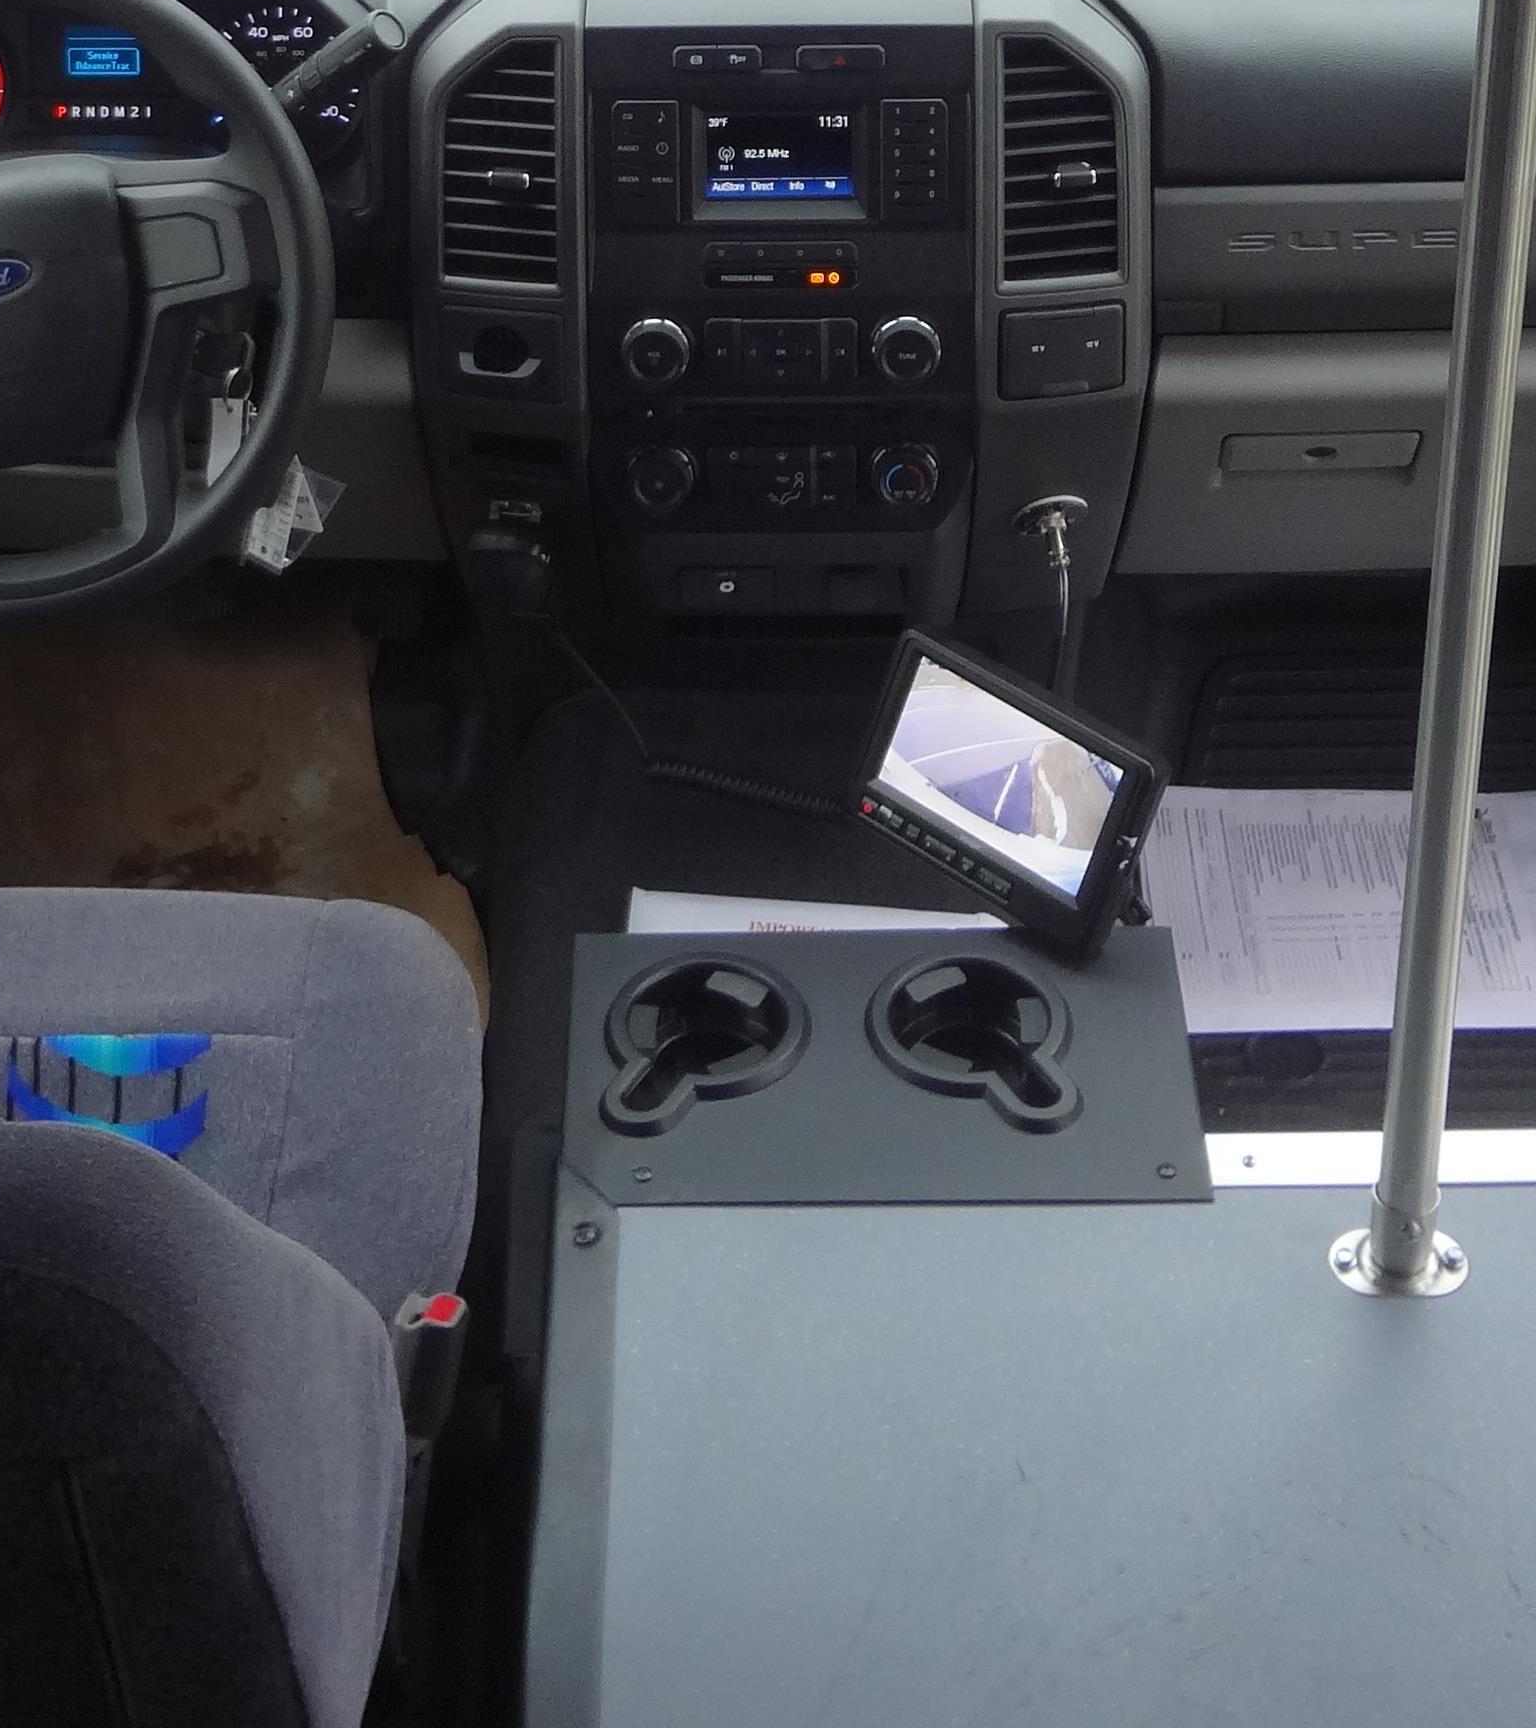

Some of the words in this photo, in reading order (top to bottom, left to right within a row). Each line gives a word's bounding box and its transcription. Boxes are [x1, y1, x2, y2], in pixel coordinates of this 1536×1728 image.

[248, 26, 269, 38] 40
[293, 26, 314, 38] 60
[818, 115, 849, 128] 11:31
[744, 149, 765, 158] 92.5
[767, 148, 790, 158] MHz
[751, 181, 774, 191] Direct
[789, 181, 805, 190] Info
